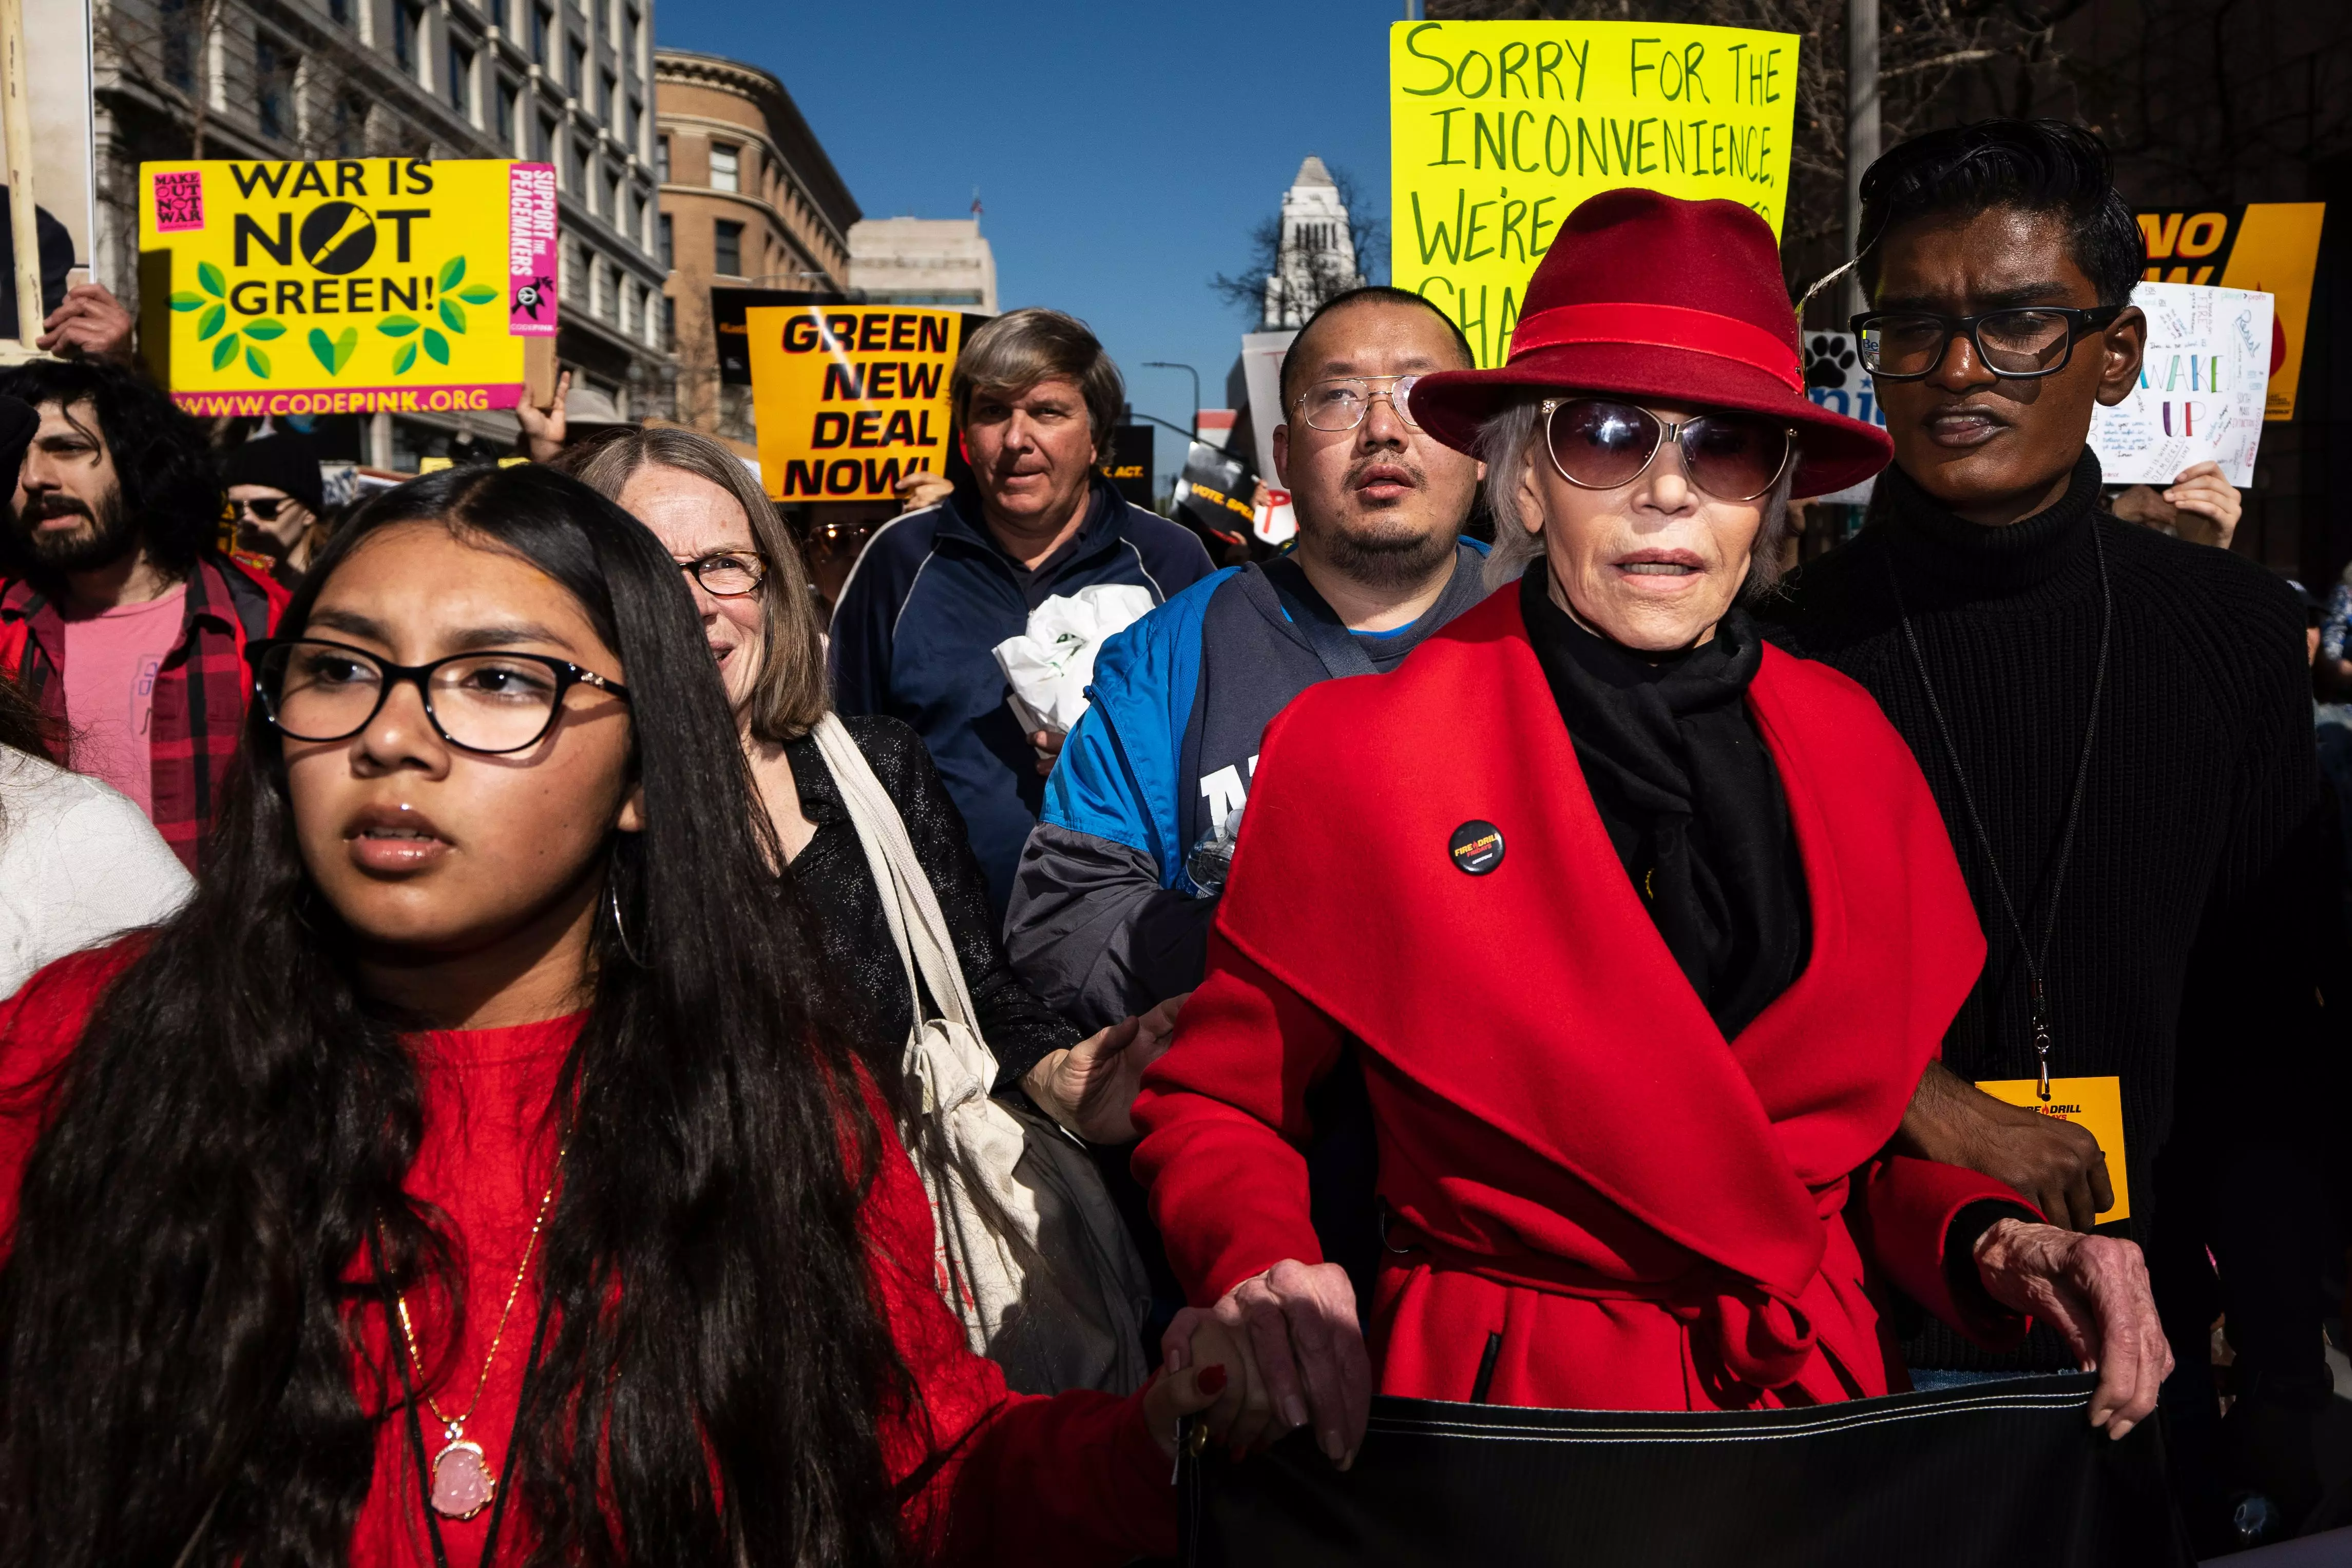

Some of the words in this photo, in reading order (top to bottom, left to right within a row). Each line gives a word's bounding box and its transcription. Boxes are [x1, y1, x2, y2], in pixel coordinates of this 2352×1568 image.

[1402, 22, 1590, 102] SORRY
[1631, 37, 1711, 104] FOR
[1727, 43, 1782, 108] THE
[1426, 107, 1774, 189] INCONVENIENCE,
[155, 174, 199, 185] MAKE
[229, 160, 368, 199] WAR
[389, 159, 434, 196] IS
[157, 196, 201, 212] NOT
[157, 210, 201, 223] WAR
[511, 169, 533, 276] PEACEMAKERS
[533, 169, 555, 240] SUPPORT
[234, 201, 431, 275] NOT
[1410, 185, 1557, 266] WE'RE
[533, 239, 547, 256] THE
[230, 276, 434, 315] GREEN!
[781, 313, 949, 354] GREEN
[821, 362, 944, 401] NEW
[2139, 354, 2224, 393] WAKE
[175, 389, 489, 416] WWW.CODEPINK.ORG
[2163, 401, 2206, 437] UP
[811, 410, 938, 450] DEAL
[1226, 498, 1255, 523] SPEA
[1455, 843, 1473, 856] FIRE
[2050, 1104, 2081, 1114] DRILL
